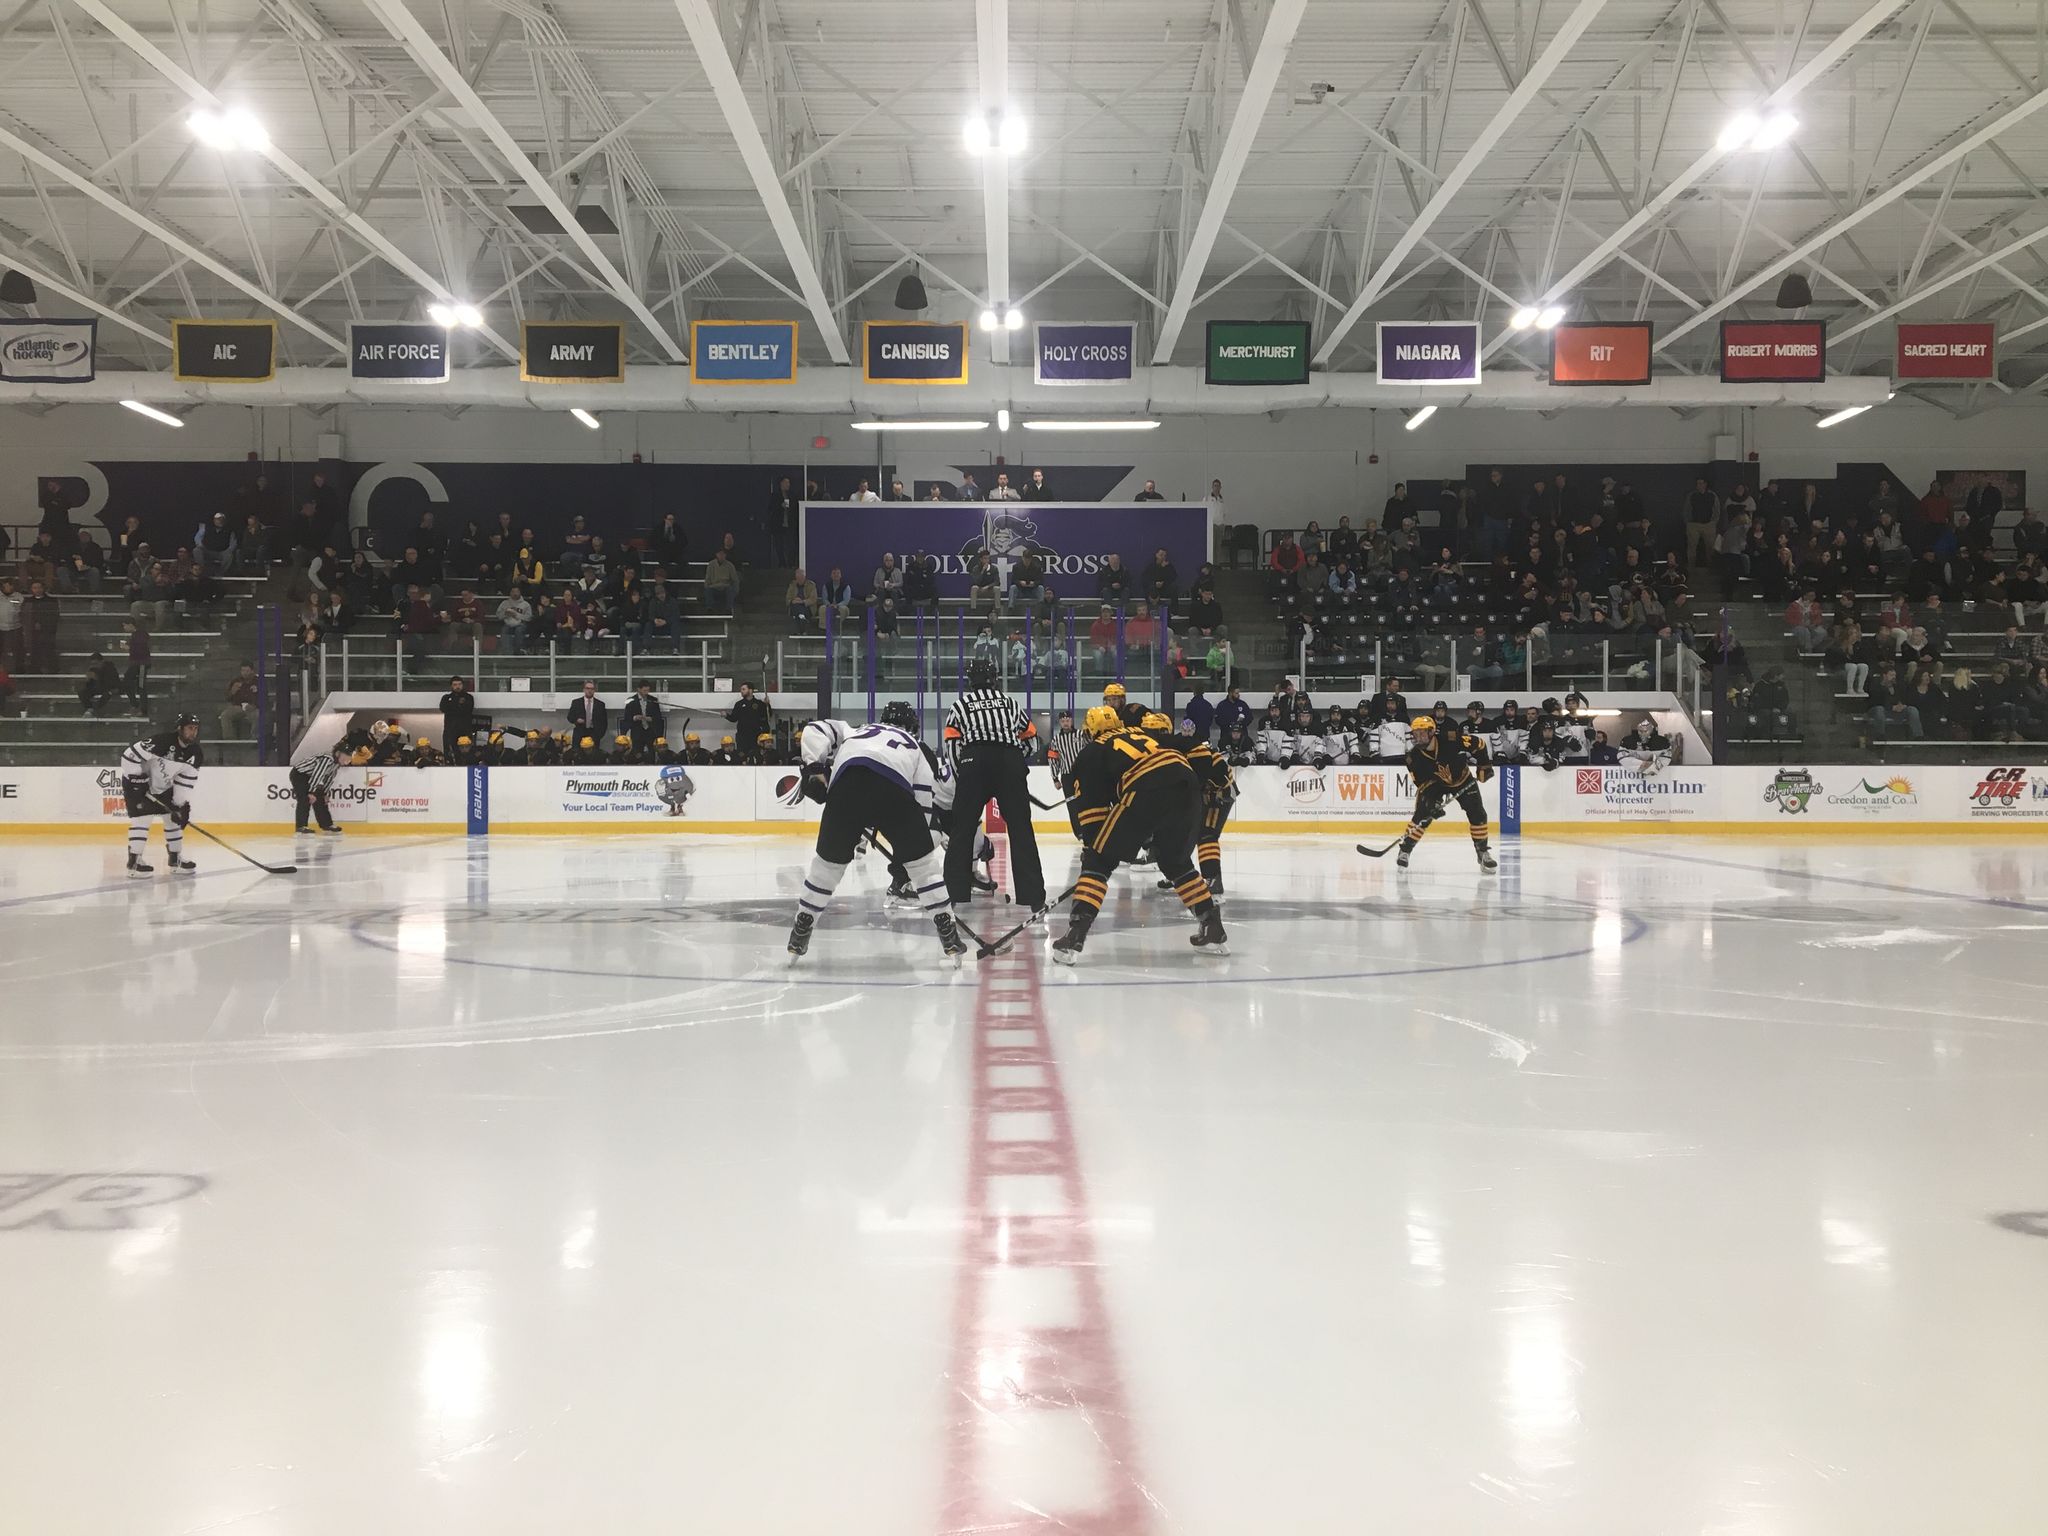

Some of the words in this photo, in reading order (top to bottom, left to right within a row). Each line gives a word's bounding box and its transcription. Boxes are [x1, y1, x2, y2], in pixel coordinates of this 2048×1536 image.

[17, 340, 60, 351] atlantic
[213, 344, 237, 360] AIC
[359, 345, 384, 360] AIR
[388, 345, 440, 360] FORCE
[550, 344, 595, 361] ARMY
[708, 344, 779, 361] BENTLEY
[881, 343, 950, 361] CANISIUS
[1219, 345, 1297, 359] MERCYHURST
[1395, 344, 1461, 361] NIAGARA
[1727, 343, 1772, 358] ROBERT
[1774, 343, 1817, 358] MORRIS
[1904, 344, 1947, 357] SACRED
[1949, 344, 1987, 357] HEART
[13, 349, 55, 361] hockey
[1043, 345, 1077, 362] HOLY
[1080, 345, 1127, 362] CROSS
[1590, 345, 1614, 363] RIT
[900, 554, 975, 574] HOLY
[1032, 554, 1110, 575] ROSS
[967, 699, 1008, 711] SWEENEY
[1338, 774, 1359, 783] FOR
[1363, 774, 1384, 783] THE
[1605, 769, 1645, 779] Hilton
[566, 780, 618, 792] Plymouth
[621, 780, 650, 791] Rock
[1287, 778, 1307, 797] THE
[1338, 784, 1384, 800] WIN
[1396, 773, 1416, 797] ME
[1604, 780, 1668, 794] Garden
[1673, 780, 1704, 794] Inn
[1764, 782, 1824, 802] Bravehearts
[1973, 782, 2028, 798] TIRE
[415, 798, 429, 806] YOU
[1605, 796, 1654, 804] Worcester
[1828, 794, 1868, 805] Creedon
[1871, 794, 1889, 804] and
[562, 803, 582, 811] Your
[585, 803, 608, 811] Local
[610, 803, 634, 811] Team
[636, 803, 663, 812] Player
